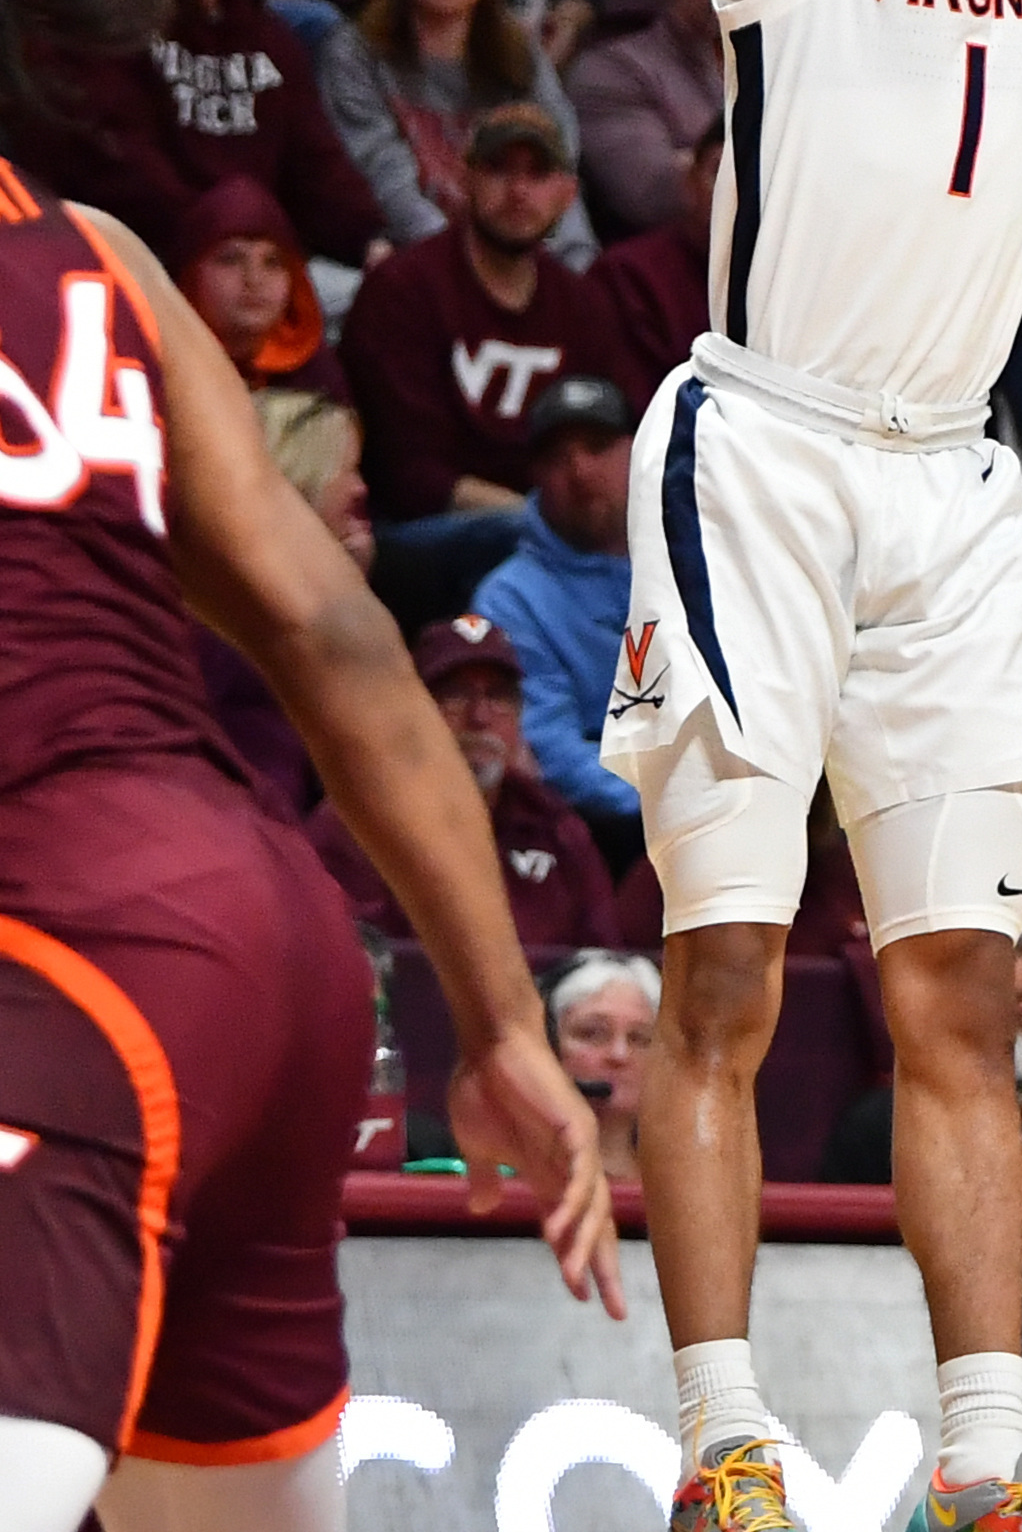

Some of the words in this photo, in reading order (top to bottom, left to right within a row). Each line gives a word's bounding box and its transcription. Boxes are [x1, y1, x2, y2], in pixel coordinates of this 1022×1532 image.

[947, 41, 988, 199] 1
[451, 337, 564, 418] VT
[509, 848, 558, 884] VT
